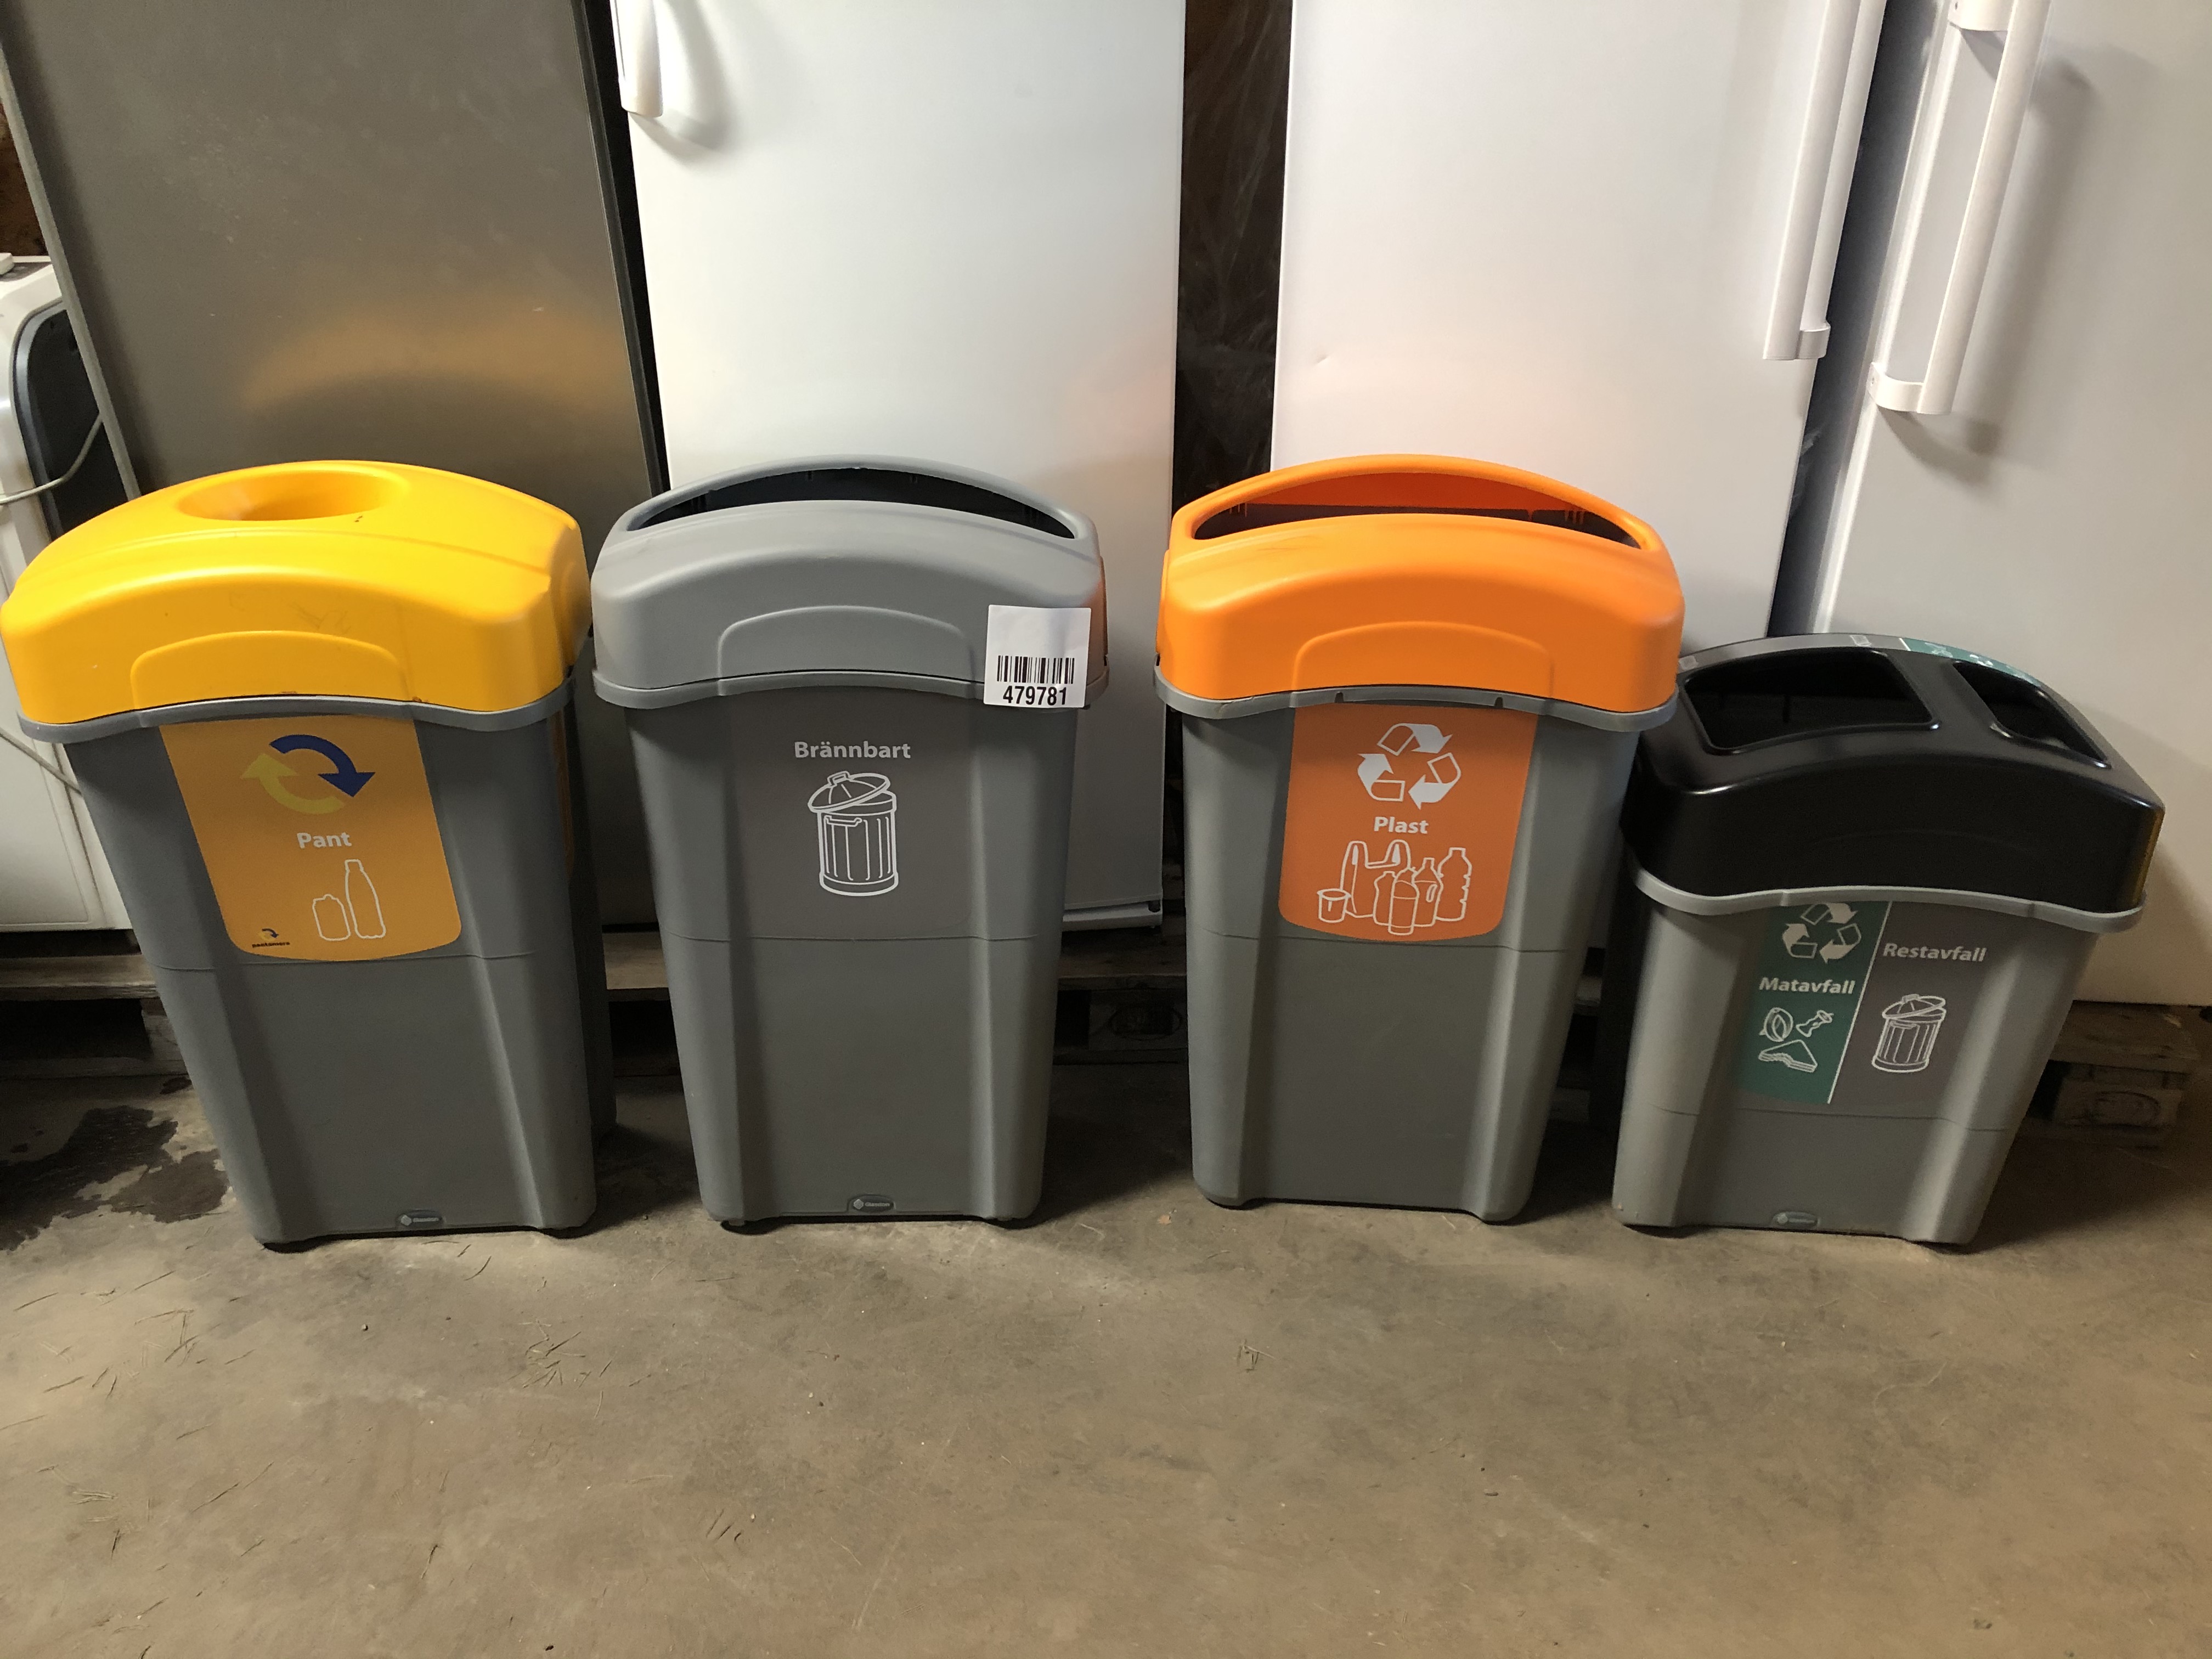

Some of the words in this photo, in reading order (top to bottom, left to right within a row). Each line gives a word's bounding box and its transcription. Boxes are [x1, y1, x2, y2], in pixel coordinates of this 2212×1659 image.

[1003, 686, 1067, 706] 479781
[794, 741, 911, 759] Brännbart
[1374, 816, 1429, 834] Plast
[297, 832, 352, 849] Pant
[1883, 943, 1987, 962] Restavfall
[1759, 977, 1855, 994] Matavfall
